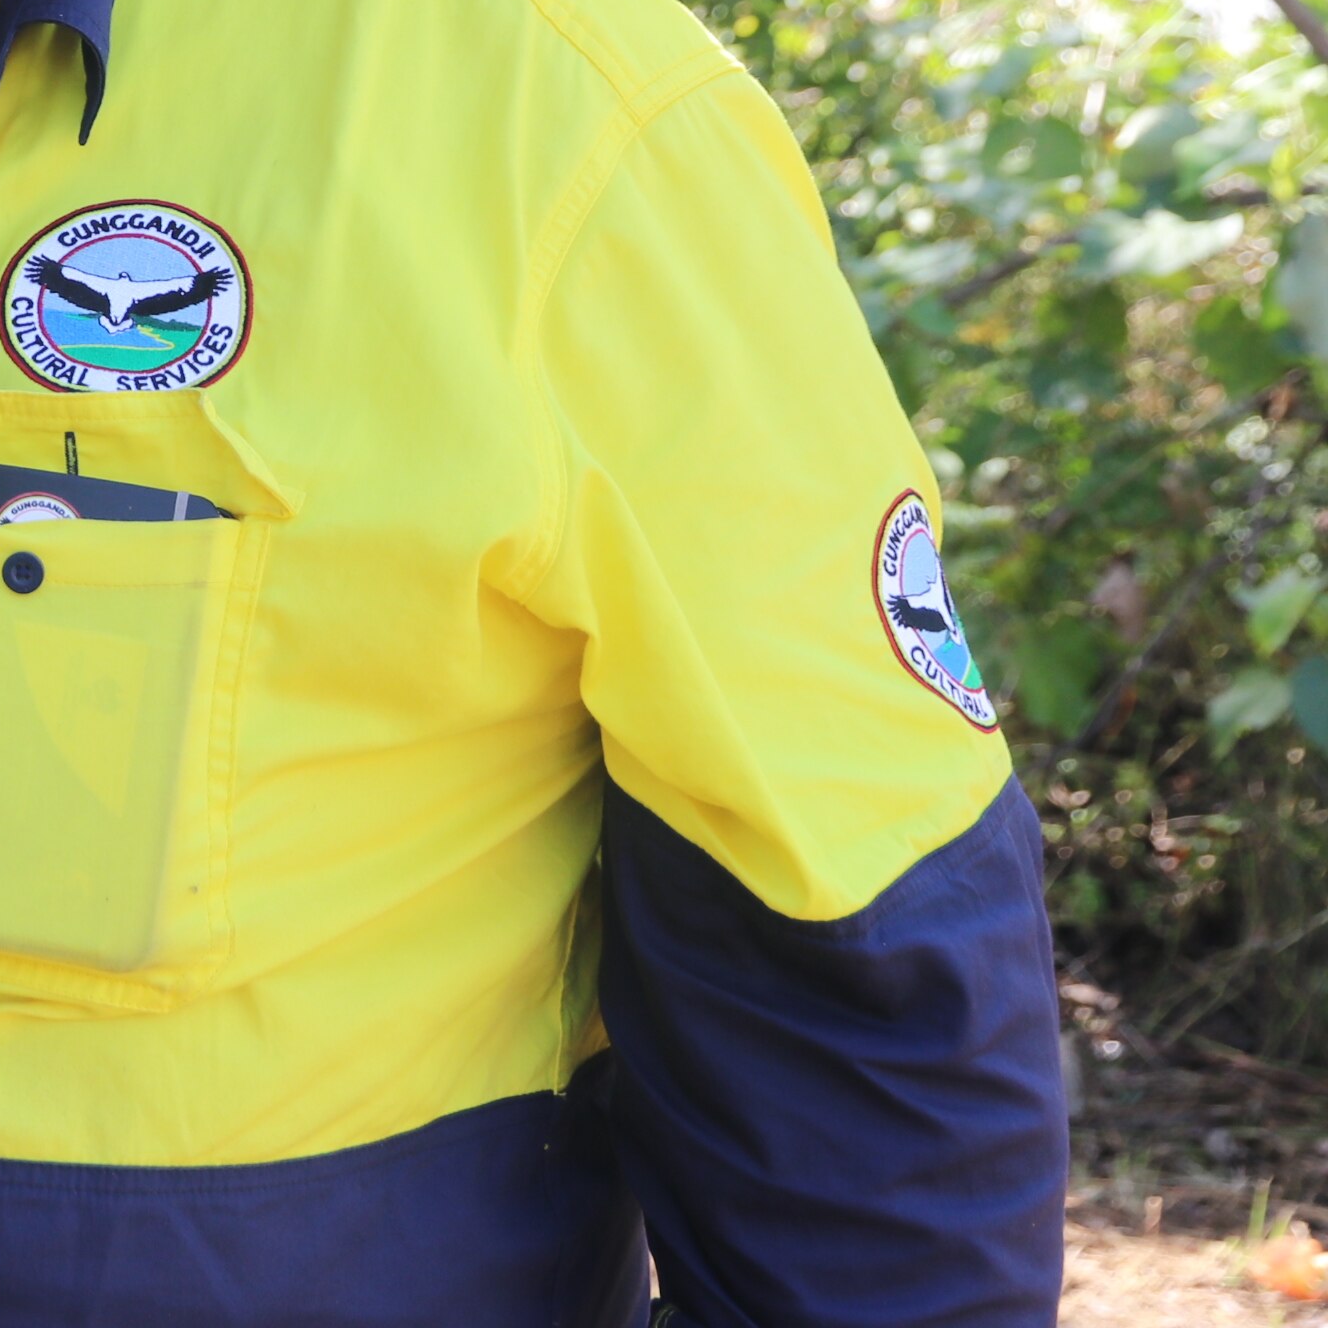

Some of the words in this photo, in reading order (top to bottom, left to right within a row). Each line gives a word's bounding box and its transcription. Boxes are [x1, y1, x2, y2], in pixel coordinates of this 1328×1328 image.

[57, 213, 216, 260] GUNGGANDJI
[11, 296, 92, 387] CULTURAL
[116, 322, 234, 391] SERVICES
